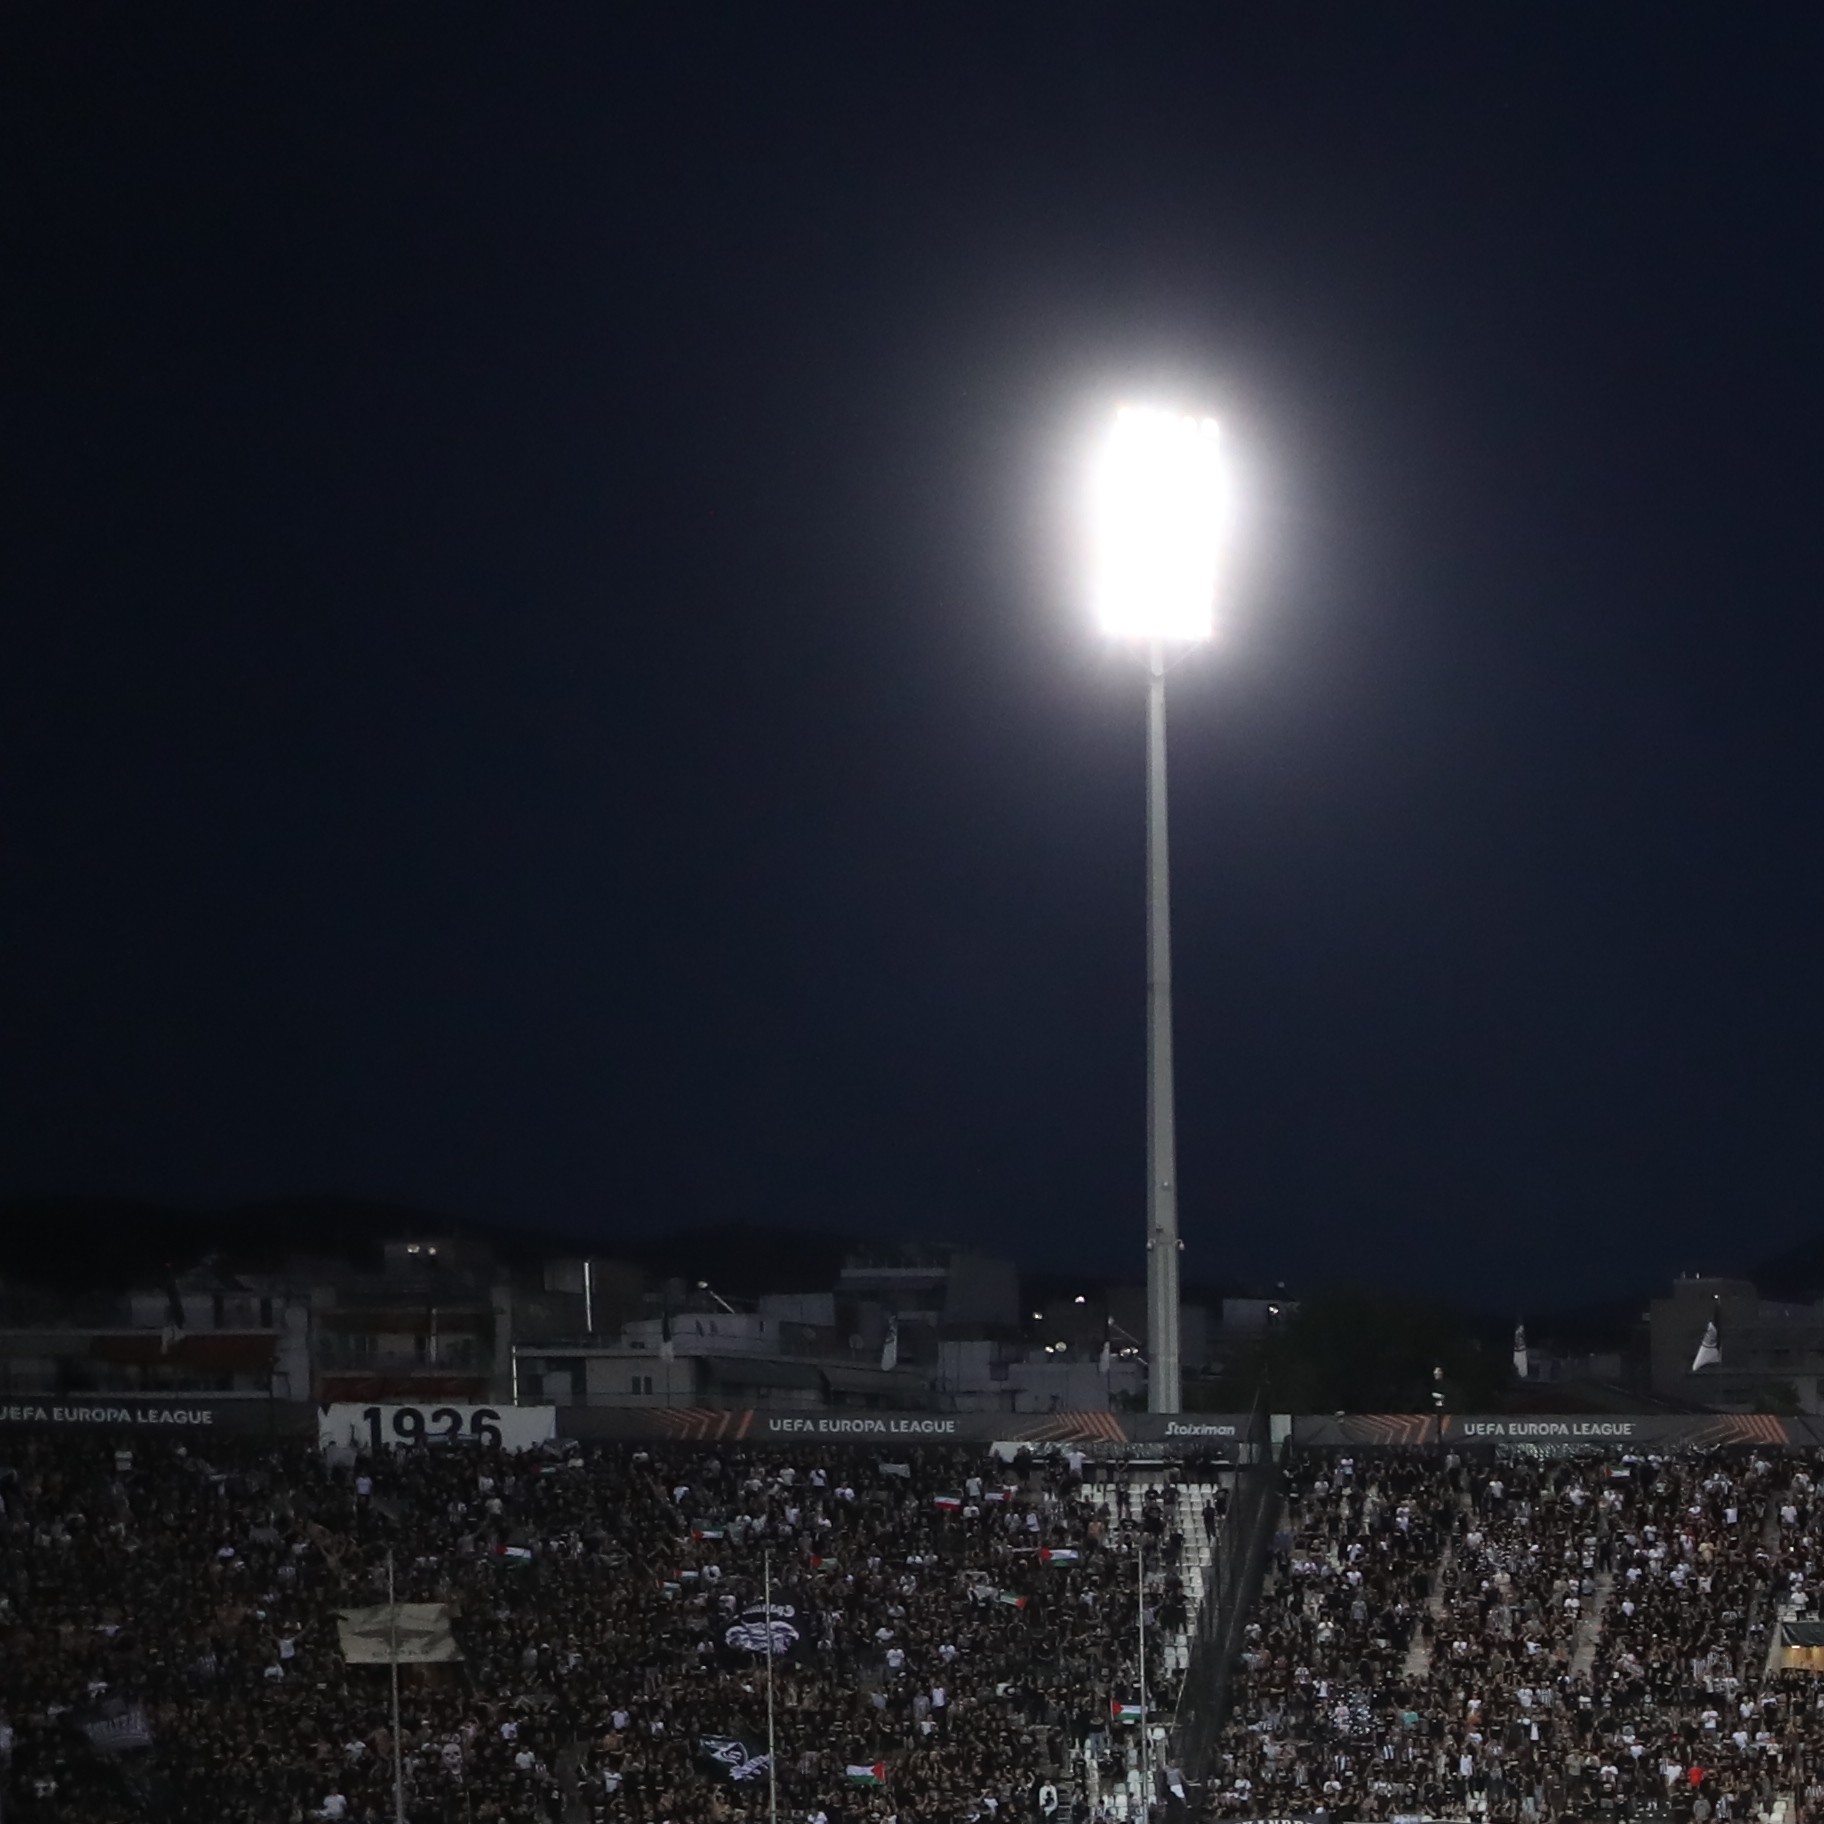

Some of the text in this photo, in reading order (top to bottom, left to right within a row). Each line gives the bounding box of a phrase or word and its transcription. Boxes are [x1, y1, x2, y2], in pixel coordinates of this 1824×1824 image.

[53, 1407, 133, 1423] EUROPA
[137, 1409, 213, 1425] LEAGUE
[363, 1407, 503, 1450] 1926
[769, 1418, 956, 1433] UEFA EUROPA LEAGUE
[1165, 1421, 1235, 1436] Stoiximan
[1464, 1423, 1505, 1436] UEFA
[1508, 1423, 1569, 1436] EUROPA
